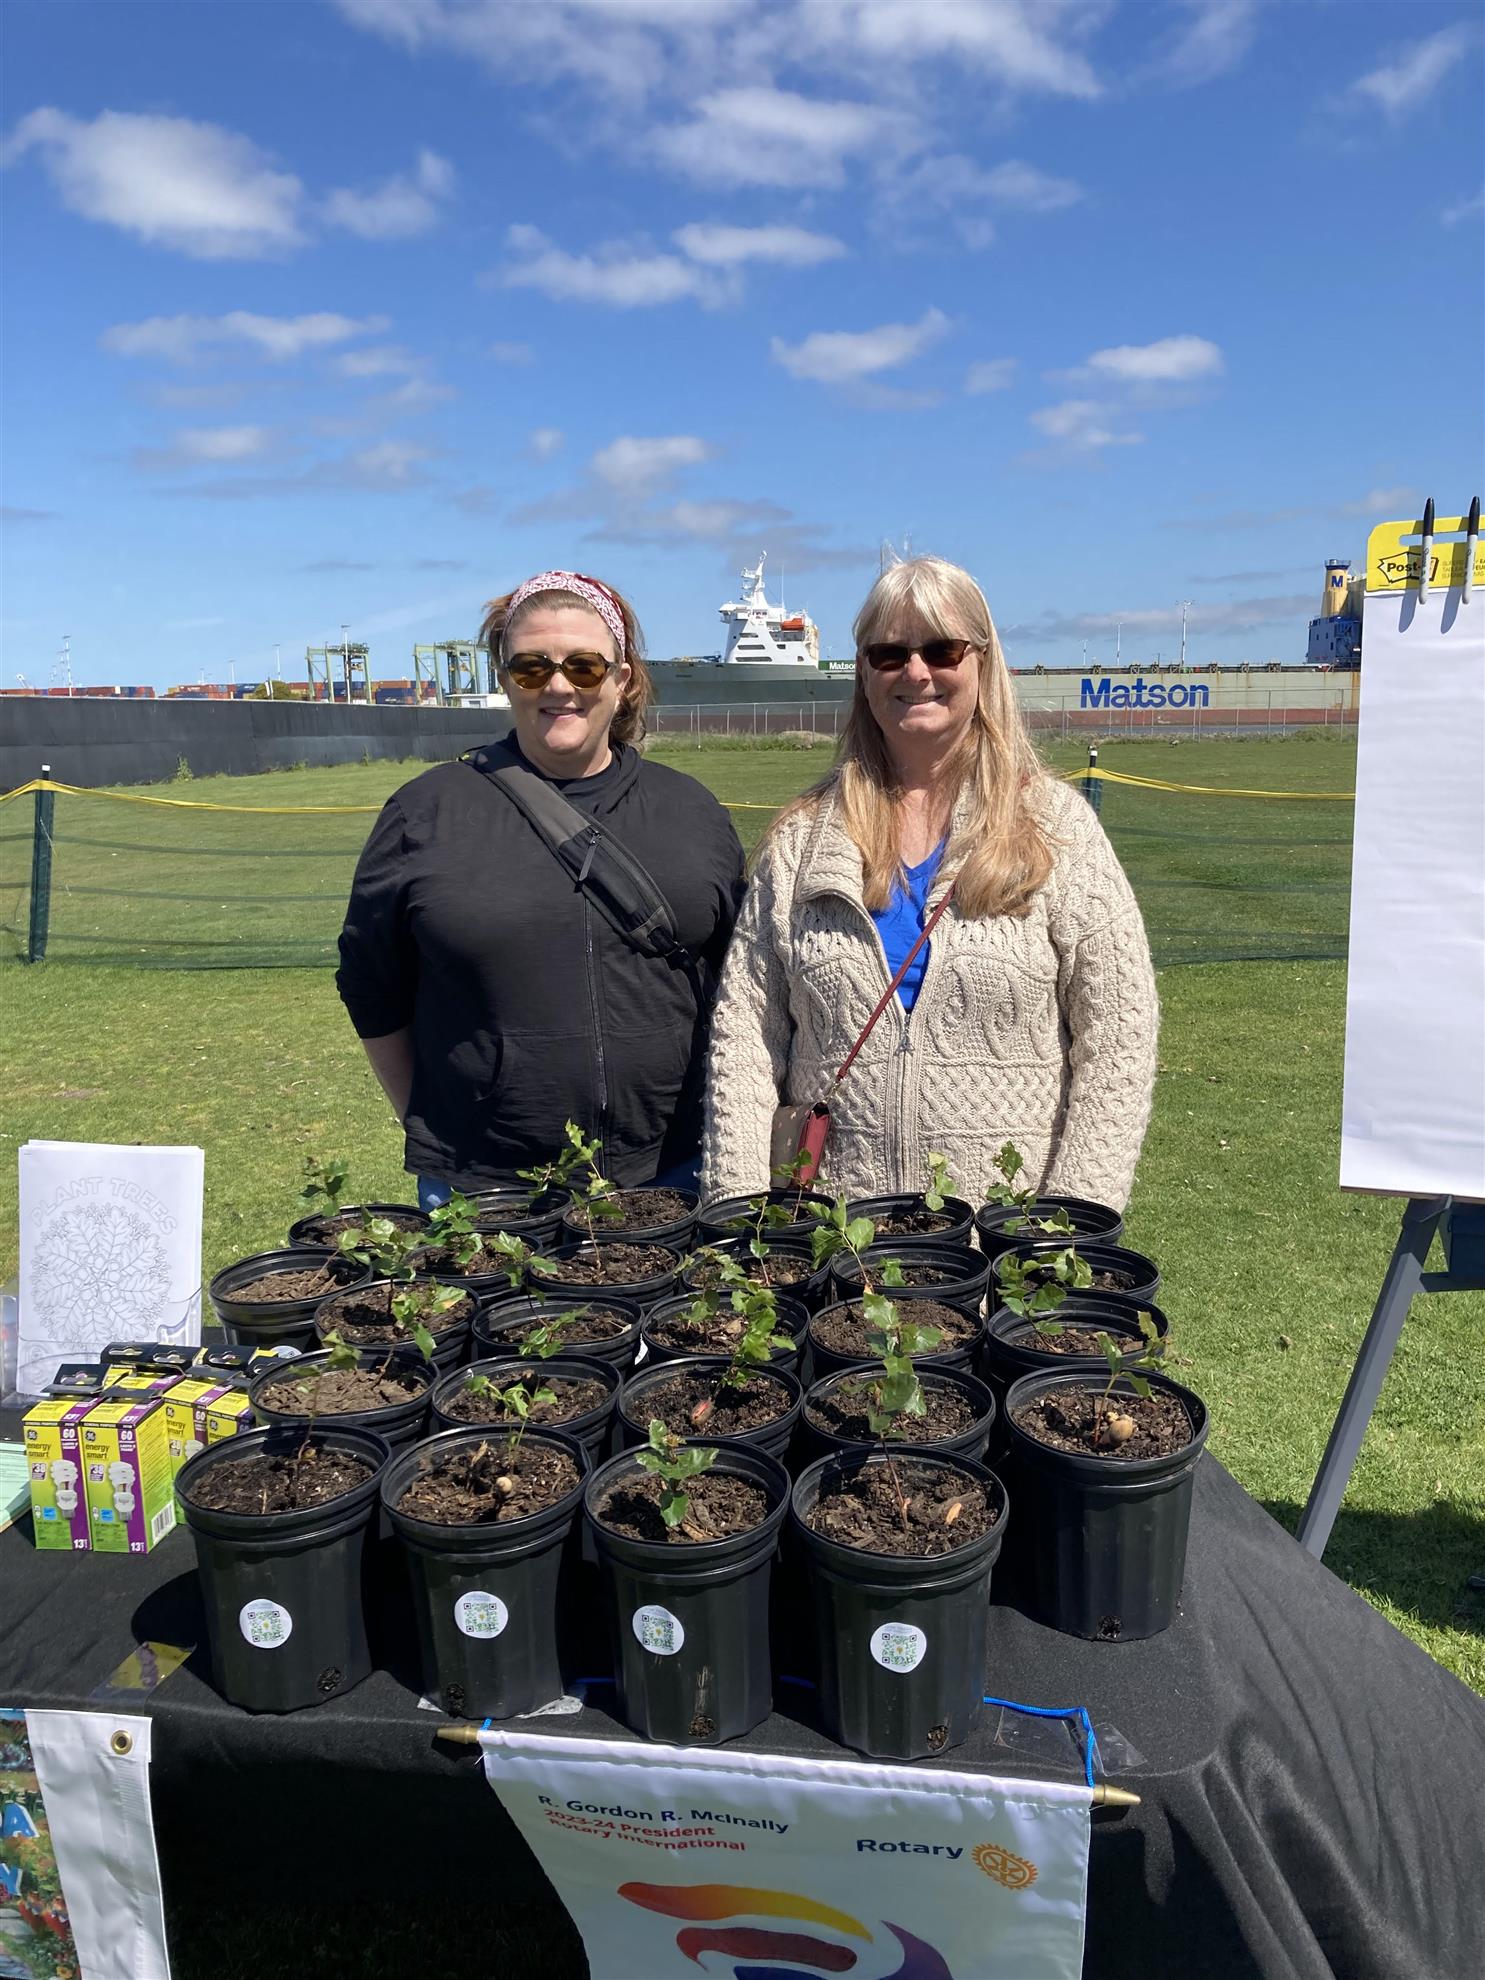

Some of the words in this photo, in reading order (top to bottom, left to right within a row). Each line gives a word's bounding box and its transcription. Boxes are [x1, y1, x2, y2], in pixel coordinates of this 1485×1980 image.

[1386, 561, 1434, 574] Post-
[1331, 575, 1344, 587] M
[1080, 677, 1210, 708] Matson
[30, 1176, 103, 1228] PLANT
[110, 1177, 178, 1236] TREES
[62, 1428, 76, 1438] 60
[120, 1430, 133, 1440] 60
[27, 1443, 51, 1452] energy
[85, 1444, 110, 1453] energy
[28, 1451, 49, 1459] smart
[86, 1452, 108, 1460] smart
[73, 1539, 84, 1549] 13
[130, 1542, 141, 1552] 13
[566, 1800, 653, 1821] Gordon
[660, 1810, 683, 1822] R.
[690, 1809, 789, 1834] McInally
[543, 1809, 615, 1829] 2023-24
[620, 1823, 716, 1838] President
[617, 1832, 746, 1851] International
[855, 1838, 964, 1860] Rotary
